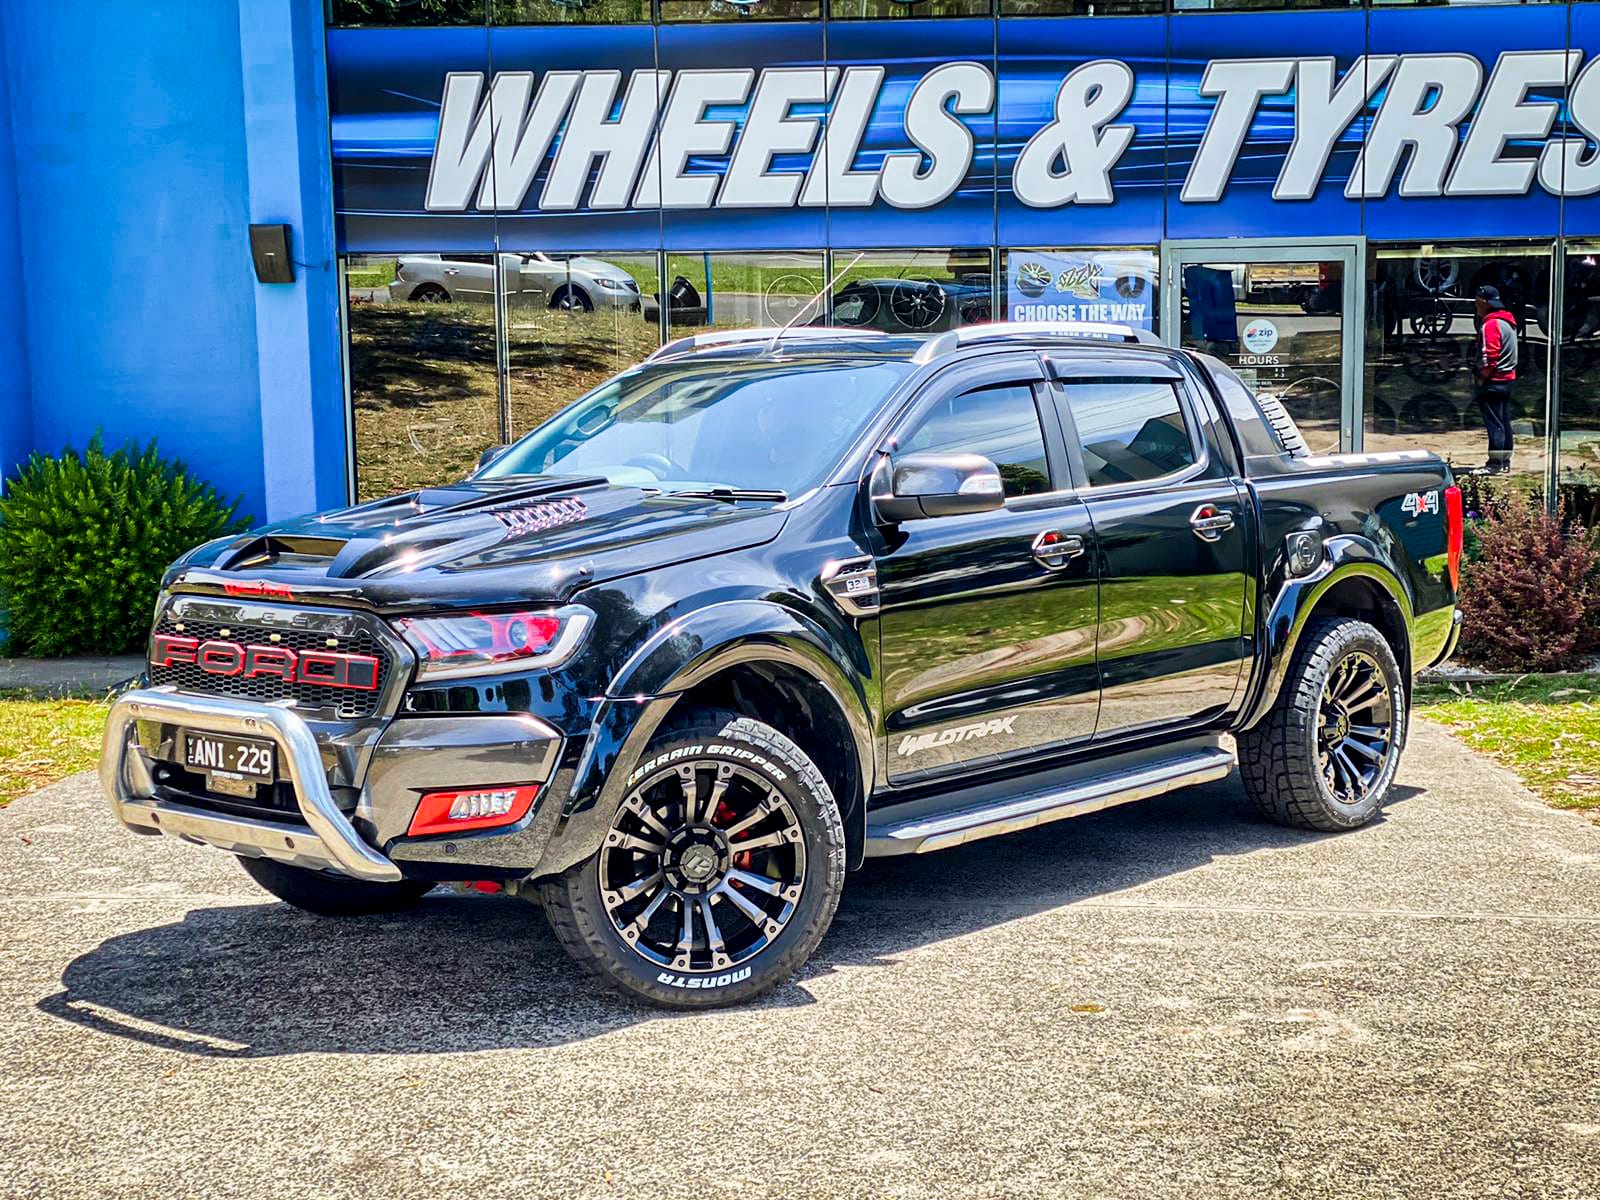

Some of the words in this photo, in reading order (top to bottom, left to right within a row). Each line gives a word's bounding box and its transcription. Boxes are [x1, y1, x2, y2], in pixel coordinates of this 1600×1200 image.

[424, 61, 995, 212] WHEELS
[1012, 58, 1135, 208] &
[1014, 305, 1075, 321] CHOOSE
[1079, 305, 1108, 321] THE
[1111, 304, 1146, 321] WAY
[1258, 327, 1273, 337] zip
[1239, 355, 1280, 365] HOURS
[151, 634, 380, 690] FORD
[898, 714, 1020, 757] WILDTRAK
[626, 745, 704, 788] TERRAIN
[706, 744, 788, 782] GRIPPER
[656, 965, 752, 990] MONSTA
